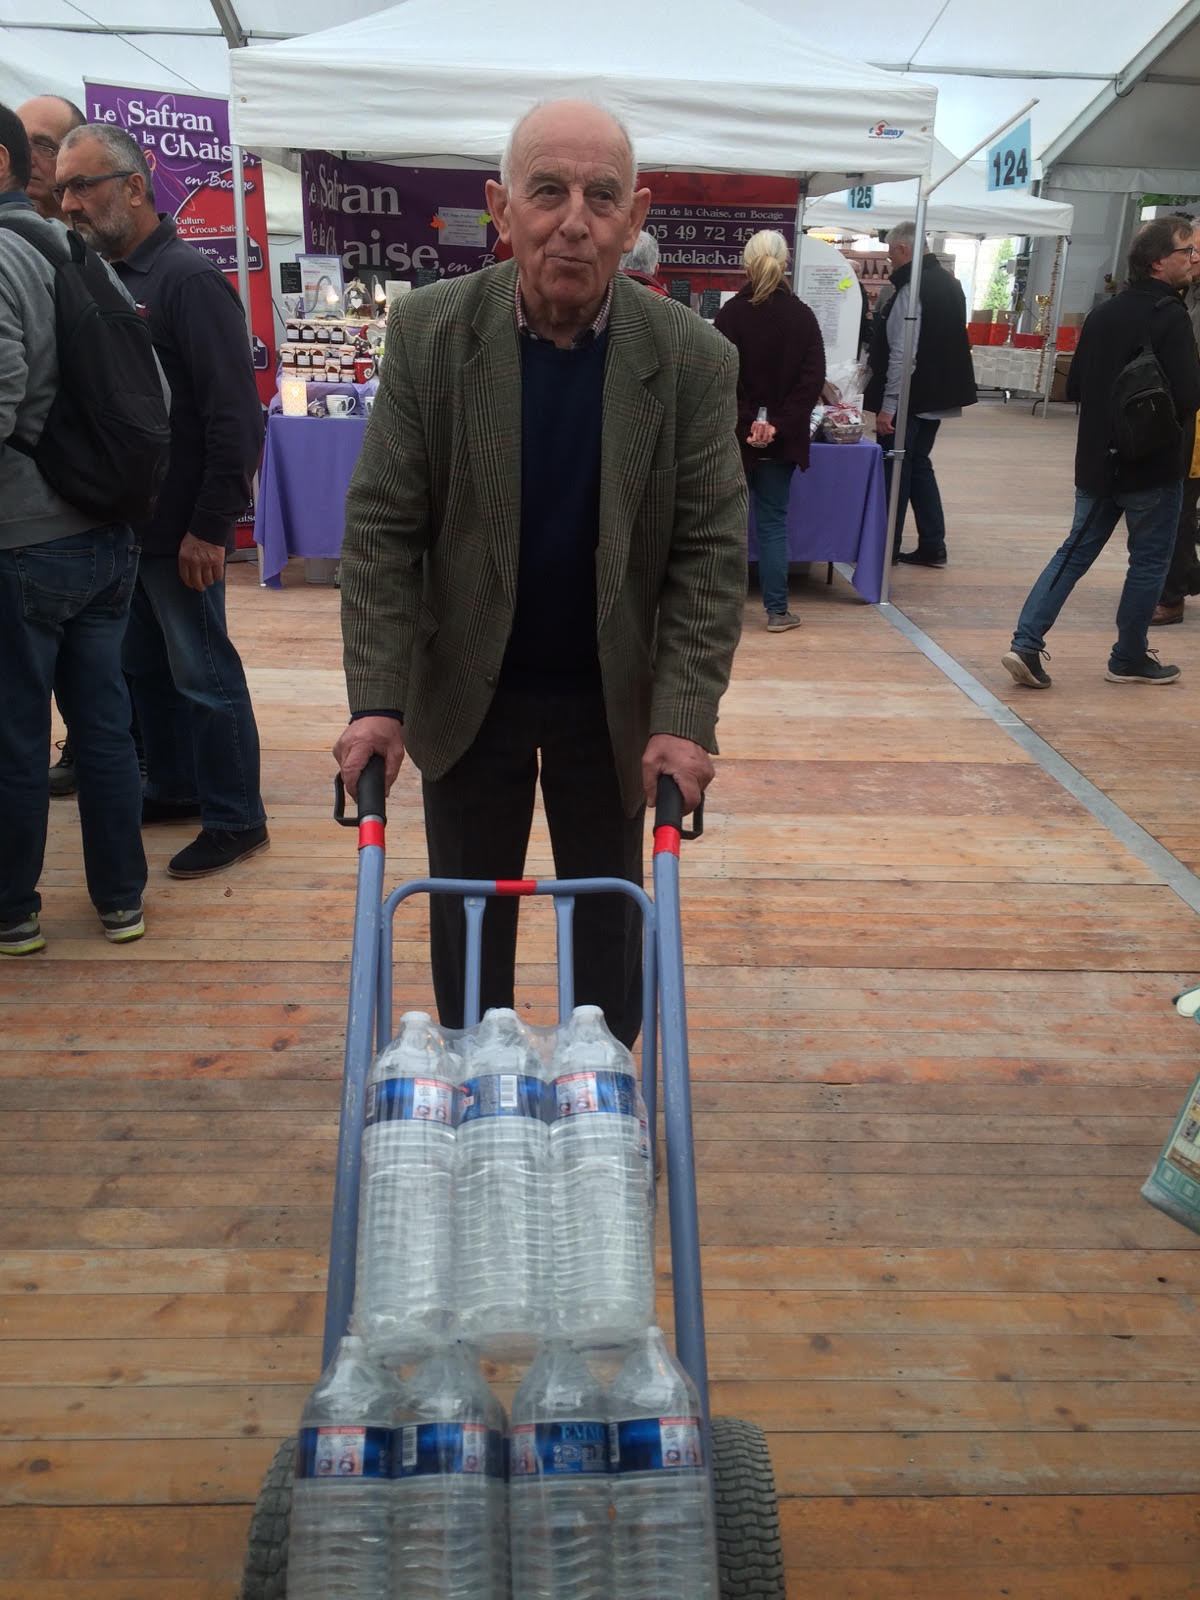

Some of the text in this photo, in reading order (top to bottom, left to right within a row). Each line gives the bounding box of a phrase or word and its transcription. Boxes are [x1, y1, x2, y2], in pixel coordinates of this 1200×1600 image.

[93, 100, 214, 132] Le Safran
[143, 131, 156, 144] la
[993, 148, 1028, 187] 124
[184, 175, 203, 186] en
[850, 186, 872, 209] 125
[669, 208, 681, 216] de
[684, 207, 693, 216] la
[750, 210, 784, 220] Bocage
[175, 216, 206, 225] Culture
[176, 226, 187, 234] de
[189, 225, 217, 233] Crocus
[645, 224, 668, 239] 05
[675, 225, 697, 241] 49
[703, 226, 726, 242] 72
[732, 227, 755, 243] 45
[216, 256, 227, 265] de
[447, 262, 473, 273] en
